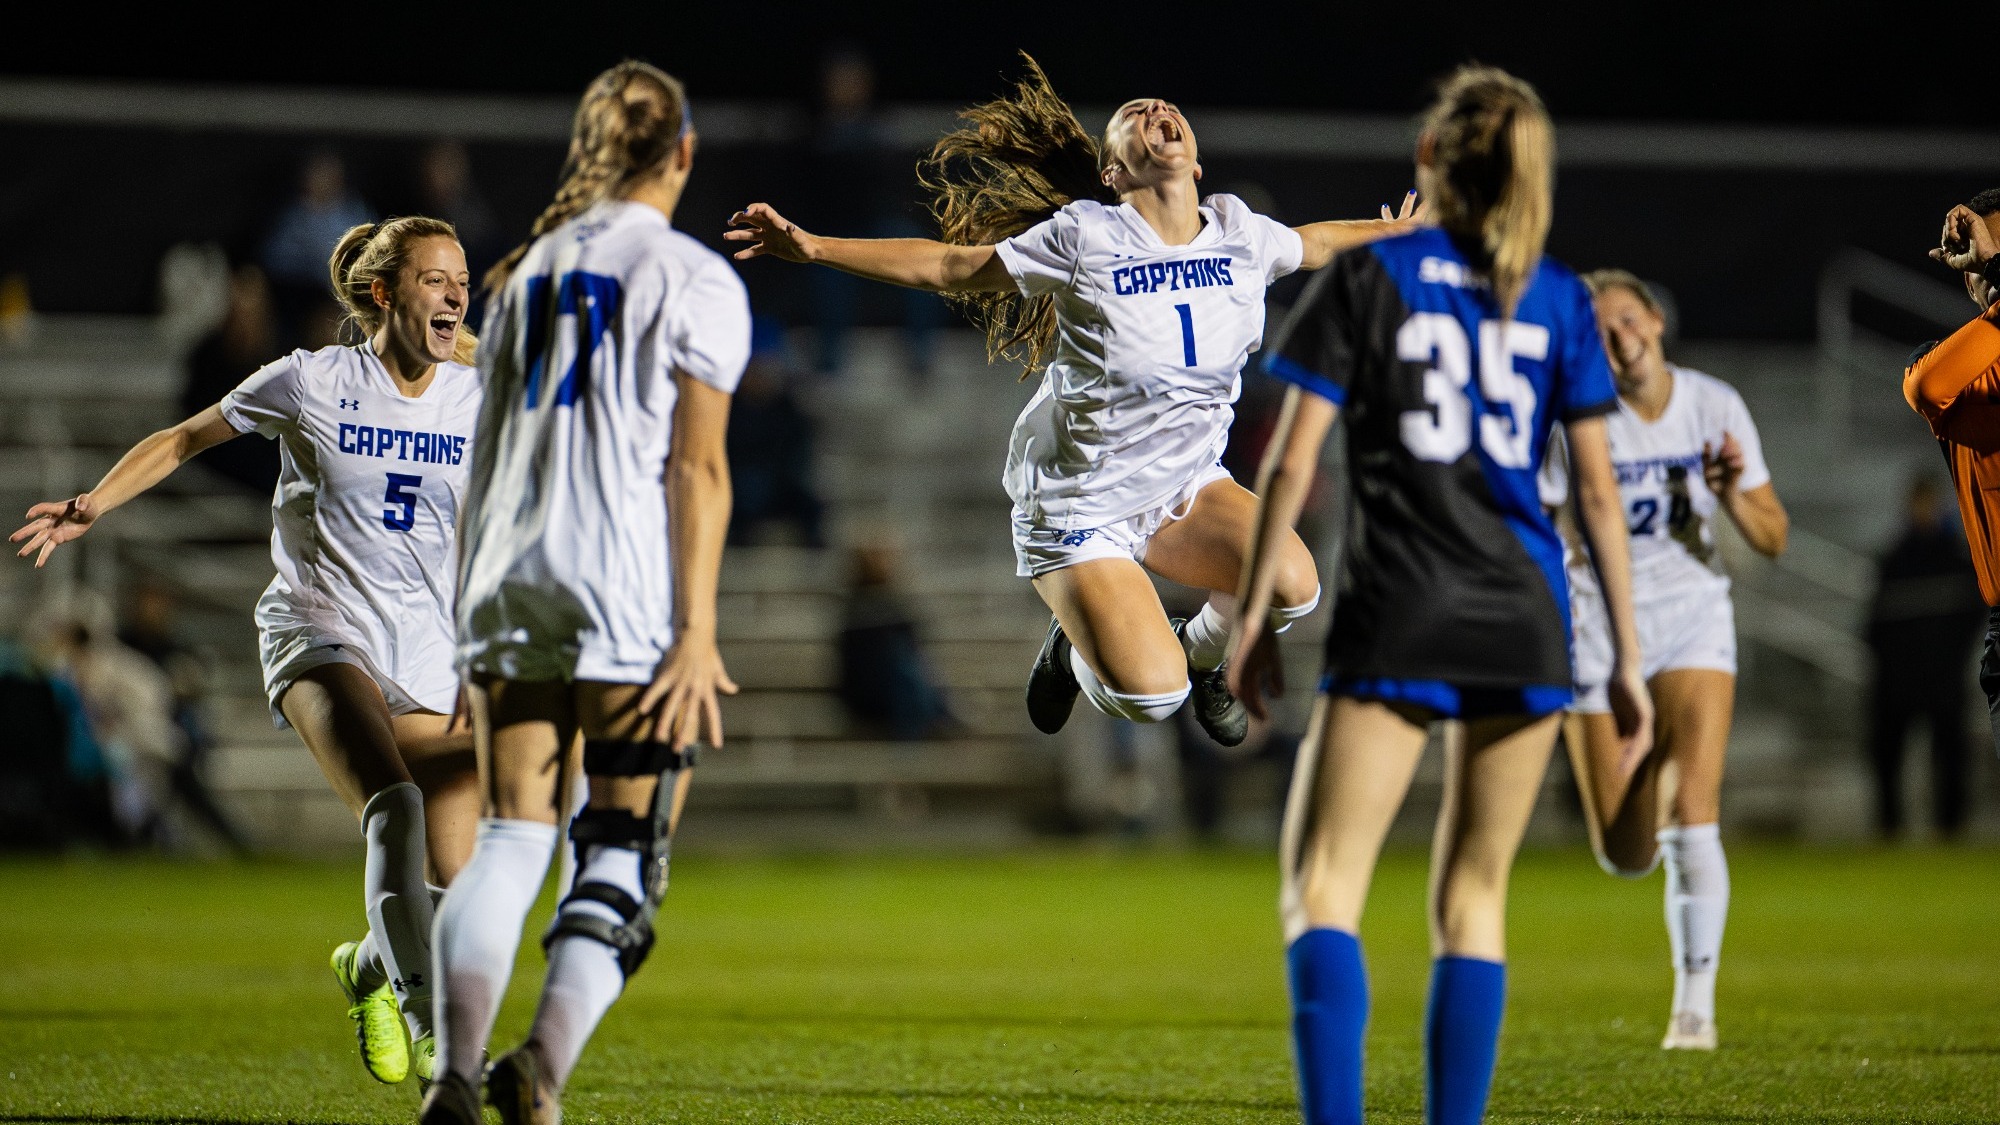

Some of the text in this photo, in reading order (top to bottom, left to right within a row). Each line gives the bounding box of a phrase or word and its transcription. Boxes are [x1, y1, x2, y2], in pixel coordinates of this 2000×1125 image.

[1112, 258, 1233, 295] CAPTAINS
[1174, 303, 1197, 367] 1
[1396, 311, 1550, 470] 35
[338, 422, 466, 465] CAPTAINS
[383, 472, 422, 531] 5
